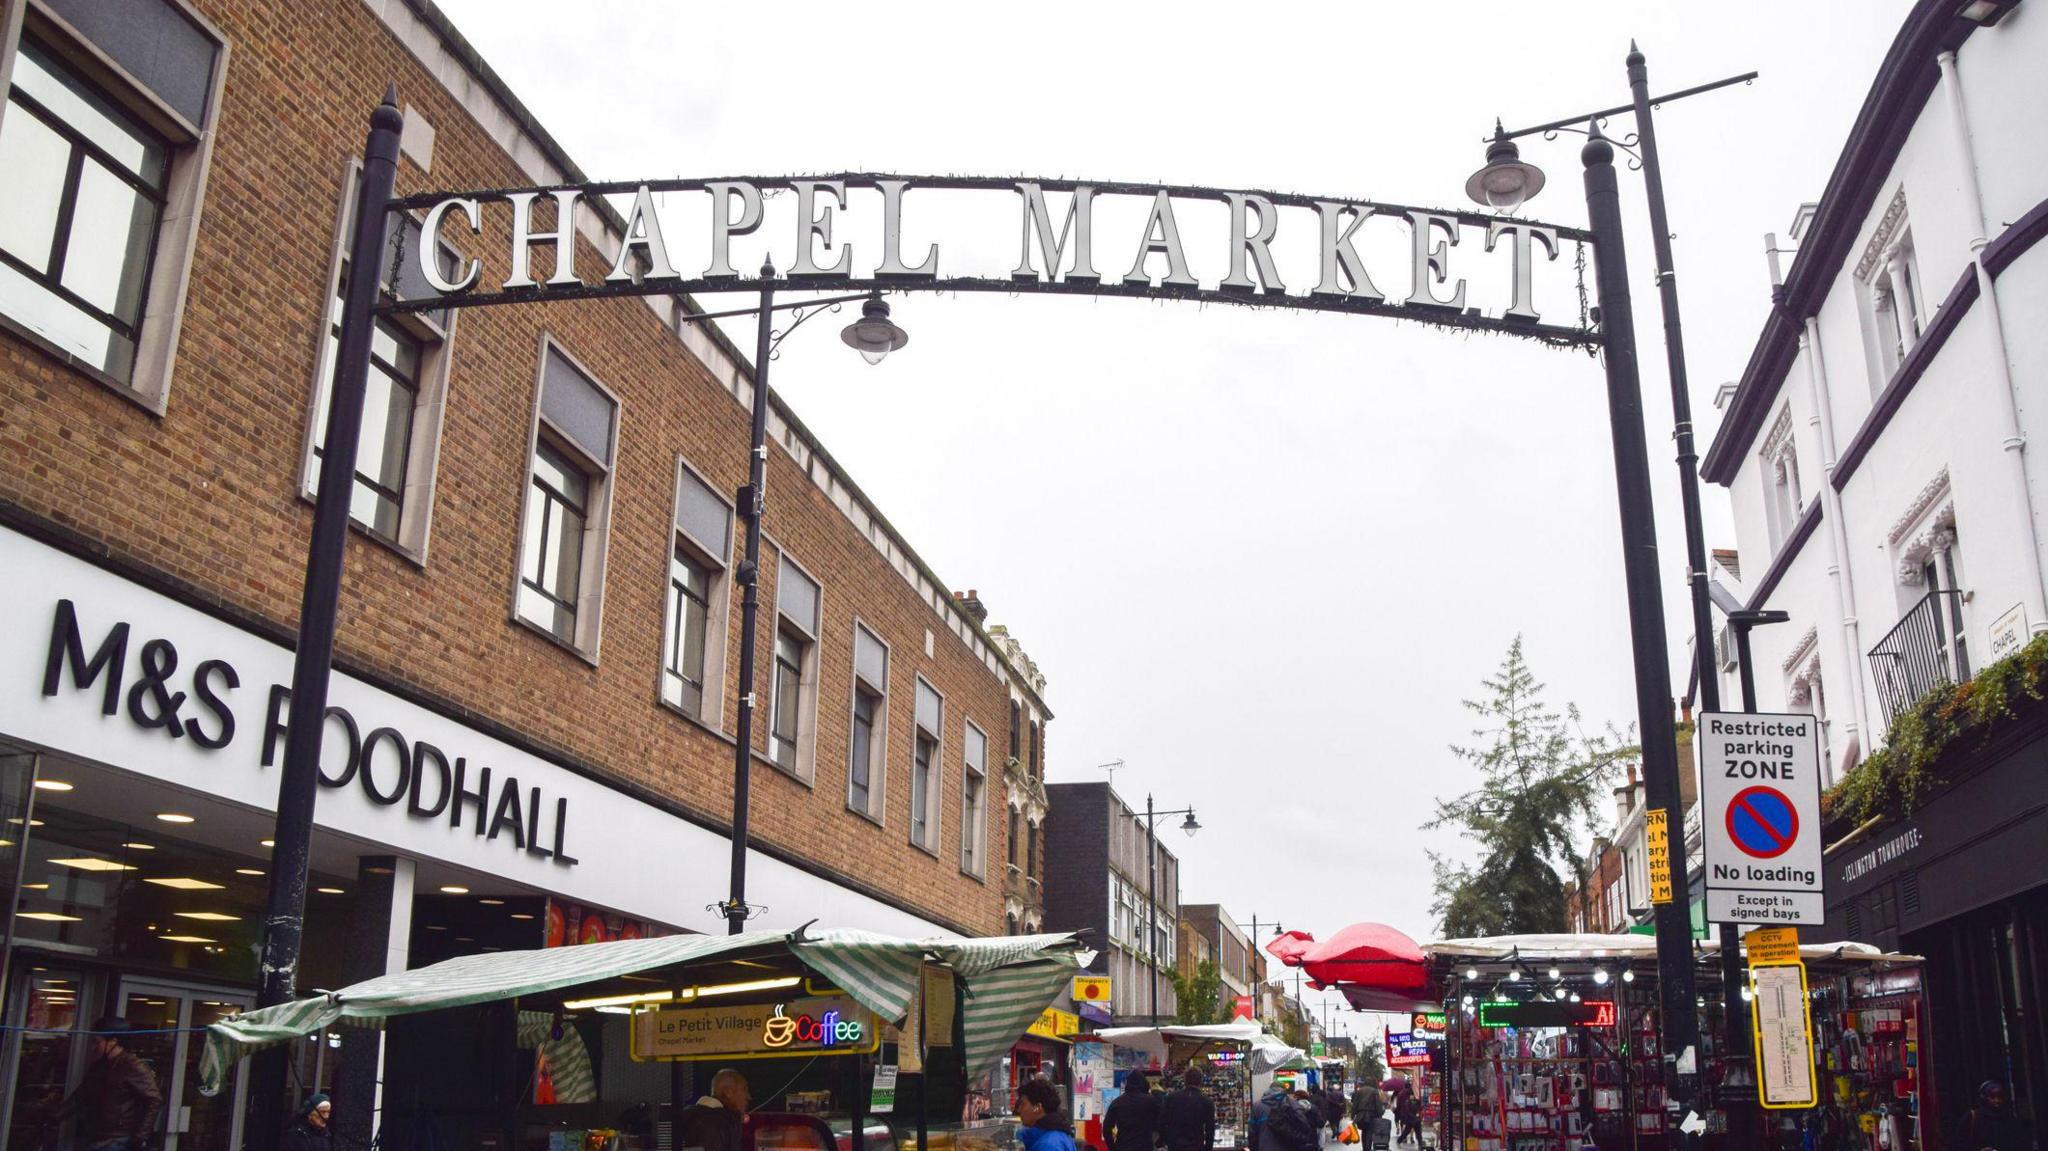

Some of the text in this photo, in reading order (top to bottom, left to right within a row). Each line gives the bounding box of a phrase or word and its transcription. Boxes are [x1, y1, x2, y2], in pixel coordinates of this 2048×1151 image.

[419, 179, 1559, 325] CHAPEL MARKET
[42, 598, 578, 866] M&S FOODHALL
[1711, 719, 1806, 737] Restricted
[1724, 740, 1793, 758] parking
[1725, 760, 1794, 780] ZONE
[1845, 827, 1919, 883] ISLINGTON TOWNHOUSE
[1714, 864, 1815, 885] No loading
[1737, 894, 1793, 907] Except in
[1731, 907, 1800, 920] signed bays
[1749, 942, 1796, 950] enforcement
[1760, 950, 1796, 958] operation
[659, 1021, 675, 1033] Le
[680, 1018, 713, 1032] Petit
[715, 1017, 762, 1031] Village
[796, 1011, 861, 1045] Coffee
